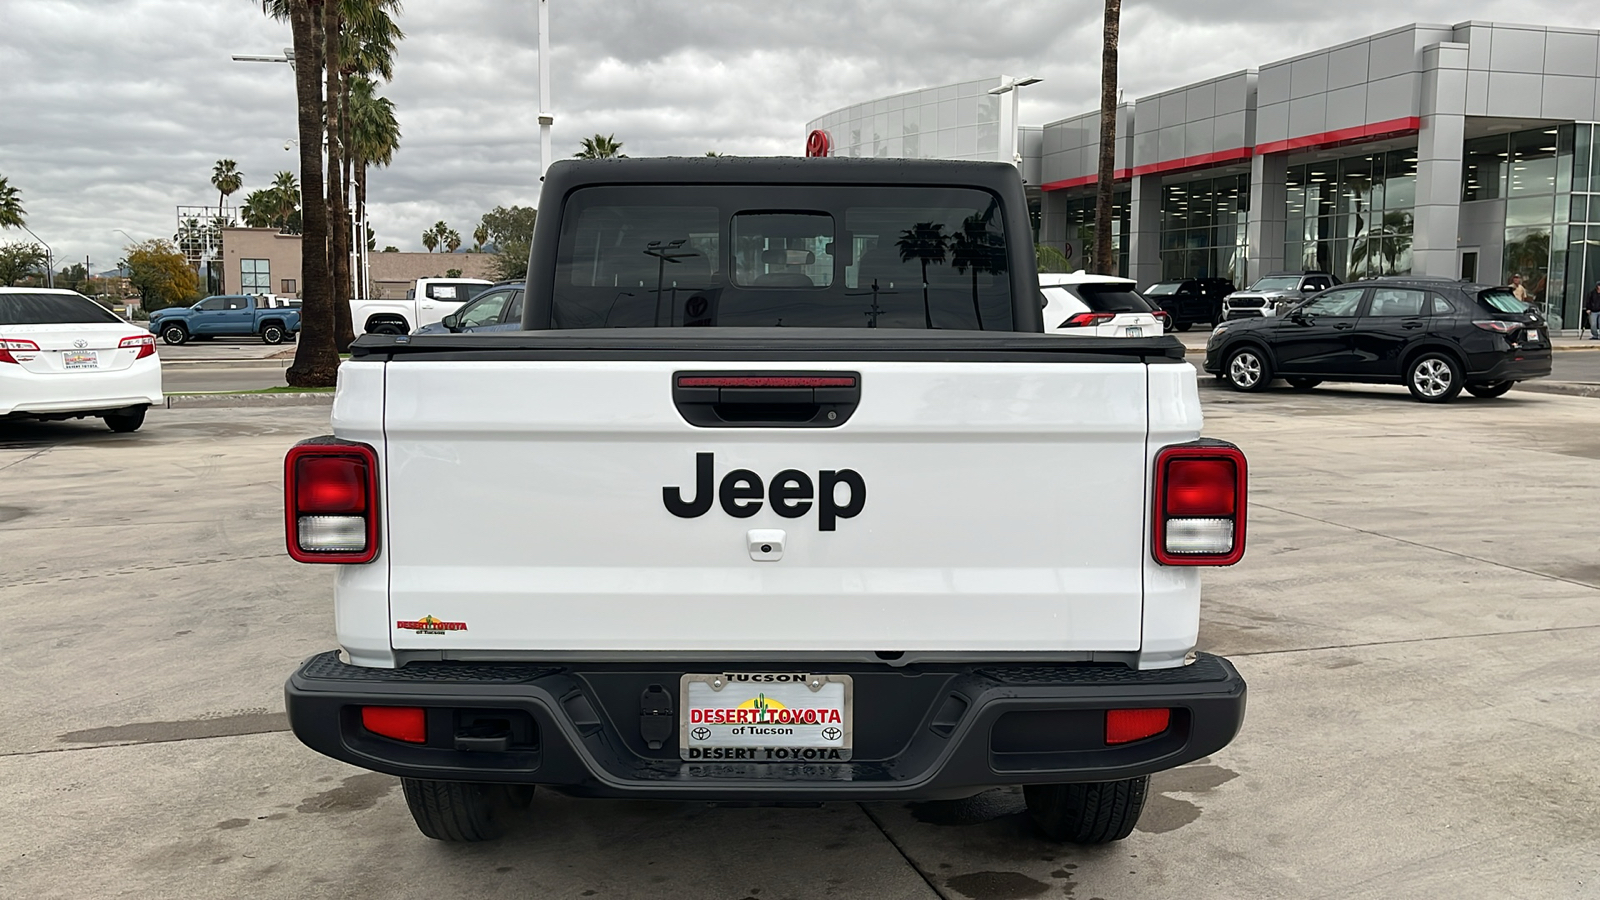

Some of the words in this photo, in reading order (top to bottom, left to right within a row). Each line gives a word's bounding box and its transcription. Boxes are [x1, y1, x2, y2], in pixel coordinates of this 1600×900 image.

[662, 452, 867, 531] Jeep
[397, 621, 429, 630] DESERT
[432, 622, 467, 631] TOYOTA
[725, 674, 807, 682] TUCSON
[691, 709, 760, 724] DESERT
[769, 709, 842, 724] TOYOTA
[732, 726, 746, 735] of
[748, 726, 793, 735] Tucson
[689, 748, 757, 759] DESERT
[764, 748, 841, 759] TOYOTA
